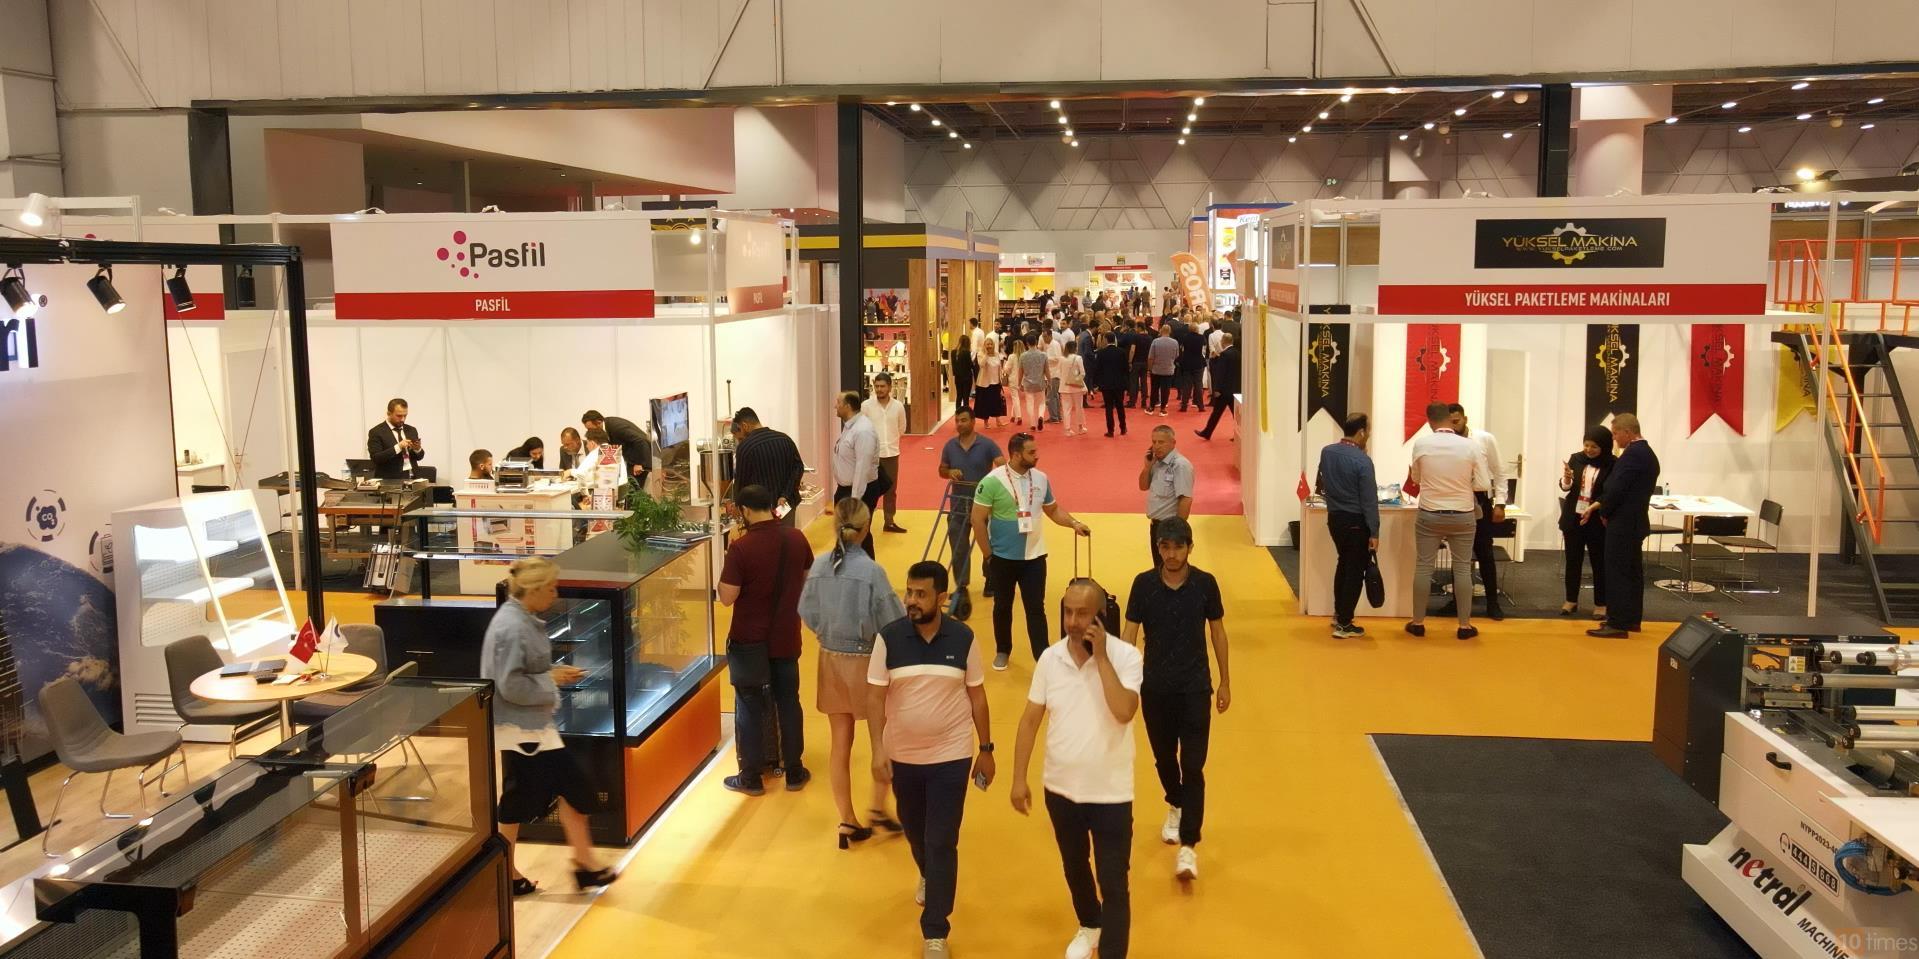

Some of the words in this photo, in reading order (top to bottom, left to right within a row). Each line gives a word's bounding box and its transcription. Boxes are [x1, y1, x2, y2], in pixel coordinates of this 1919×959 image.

[1502, 235, 1567, 247] YÜKSEL
[1570, 234, 1638, 247] MAKİNA
[469, 242, 546, 268] Pasfil
[475, 297, 511, 312] PASFİL
[1465, 290, 1512, 306] YÜKSEL
[1514, 292, 1586, 306] PAKETLEME
[1589, 289, 1670, 306] MAKİNALARI
[1811, 863, 1817, 874] 5
[1728, 847, 1813, 917] netral
